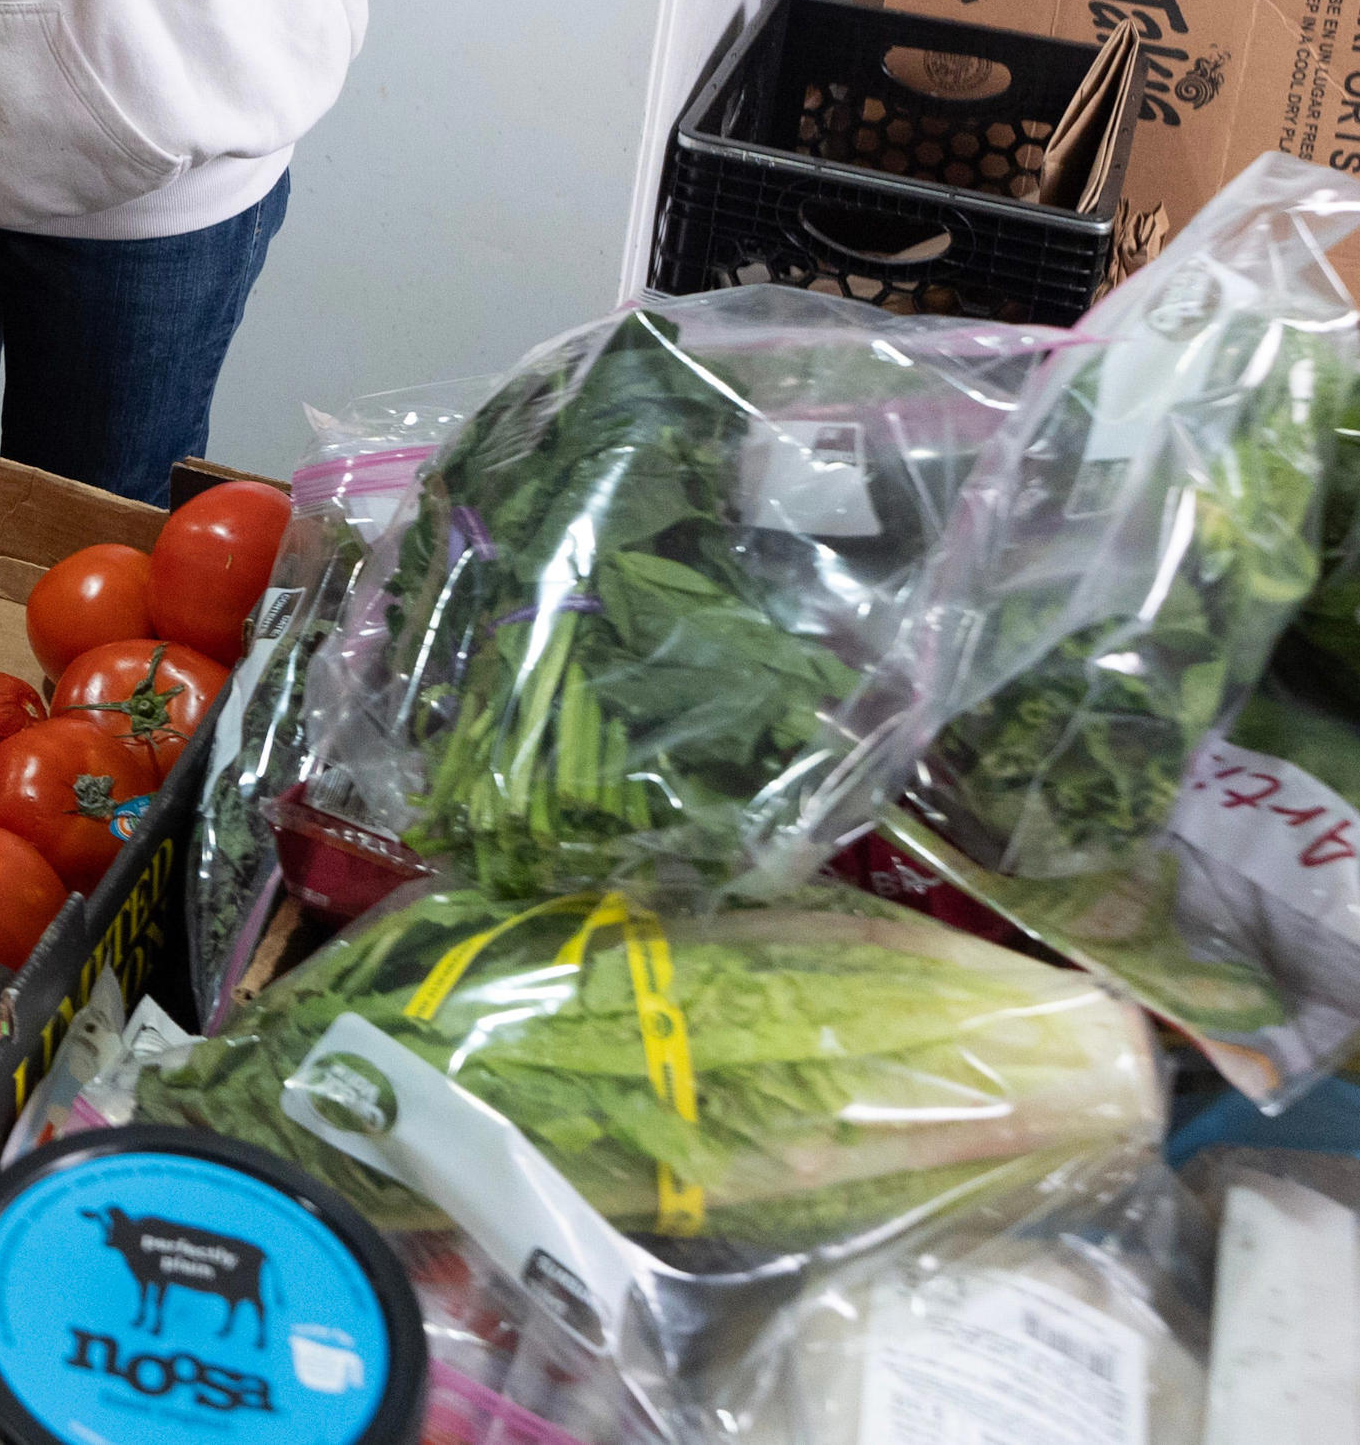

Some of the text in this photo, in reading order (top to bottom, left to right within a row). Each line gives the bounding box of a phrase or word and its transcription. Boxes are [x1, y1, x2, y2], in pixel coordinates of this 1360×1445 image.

[1302, 15, 1316, 34] IN
[1290, 47, 1310, 92] COOL
[1285, 93, 1303, 127] DRY
[1278, 126, 1296, 154] PLA
[1298, 121, 1318, 161] FRES
[141, 1233, 239, 1272] perfectly
[160, 1253, 217, 1281] plain
[66, 1327, 279, 1412] noosa
